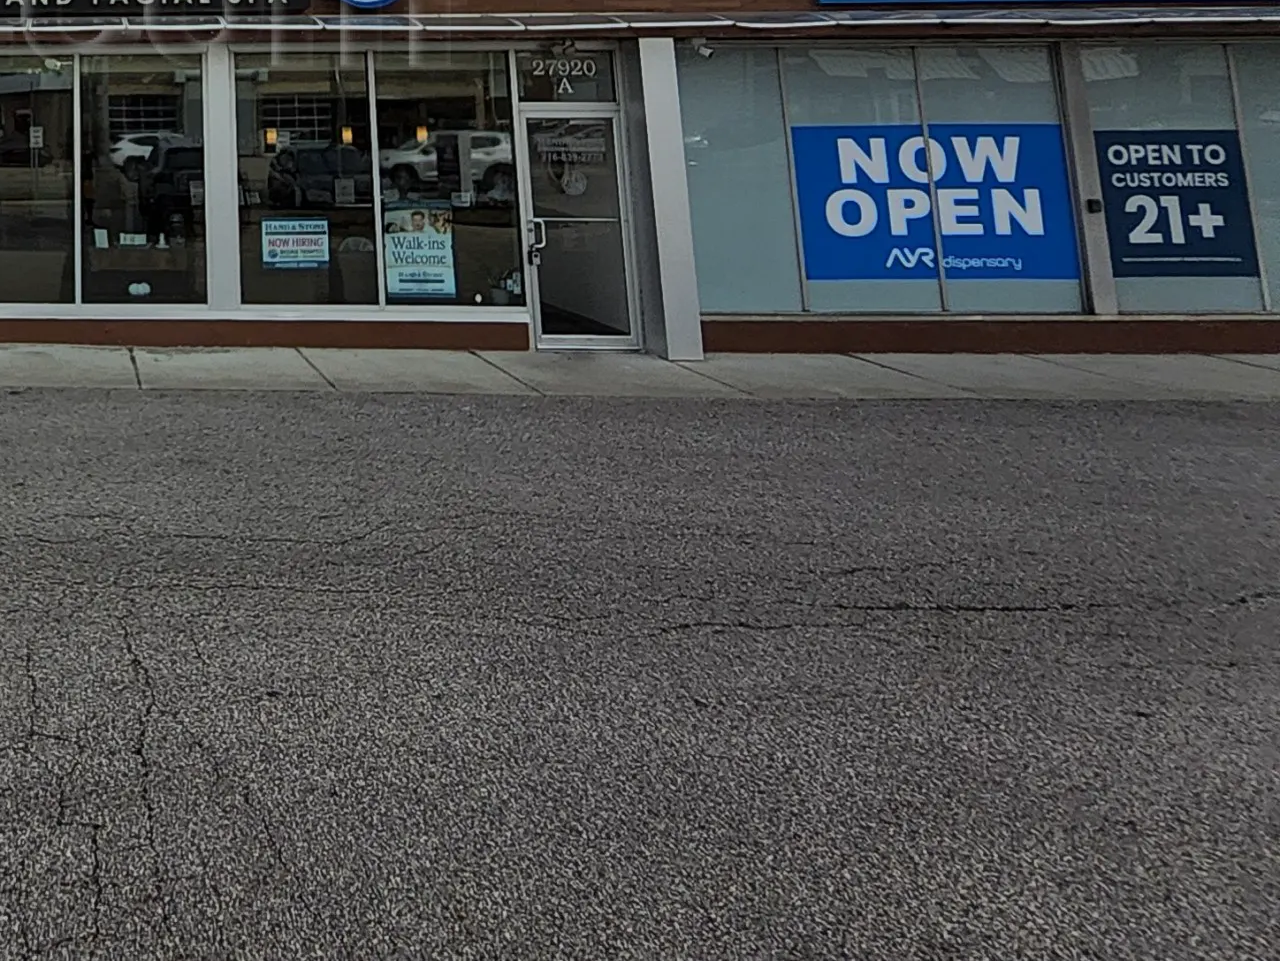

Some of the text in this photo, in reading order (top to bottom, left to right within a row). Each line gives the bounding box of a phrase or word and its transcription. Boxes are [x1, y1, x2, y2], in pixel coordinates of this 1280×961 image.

[532, 59, 596, 77] 27920
[558, 78, 574, 93] A
[837, 137, 1020, 183] NOW
[1107, 144, 1226, 165] OPEN TO
[1111, 172, 1229, 187] CUSTOMERS
[825, 189, 1044, 237] OPEN
[1124, 194, 1225, 244] 21+
[268, 238, 324, 247] NOW HIRING
[391, 236, 446, 250] Walk-ins
[392, 251, 447, 264] Welcome
[942, 255, 1022, 271] dispensary
